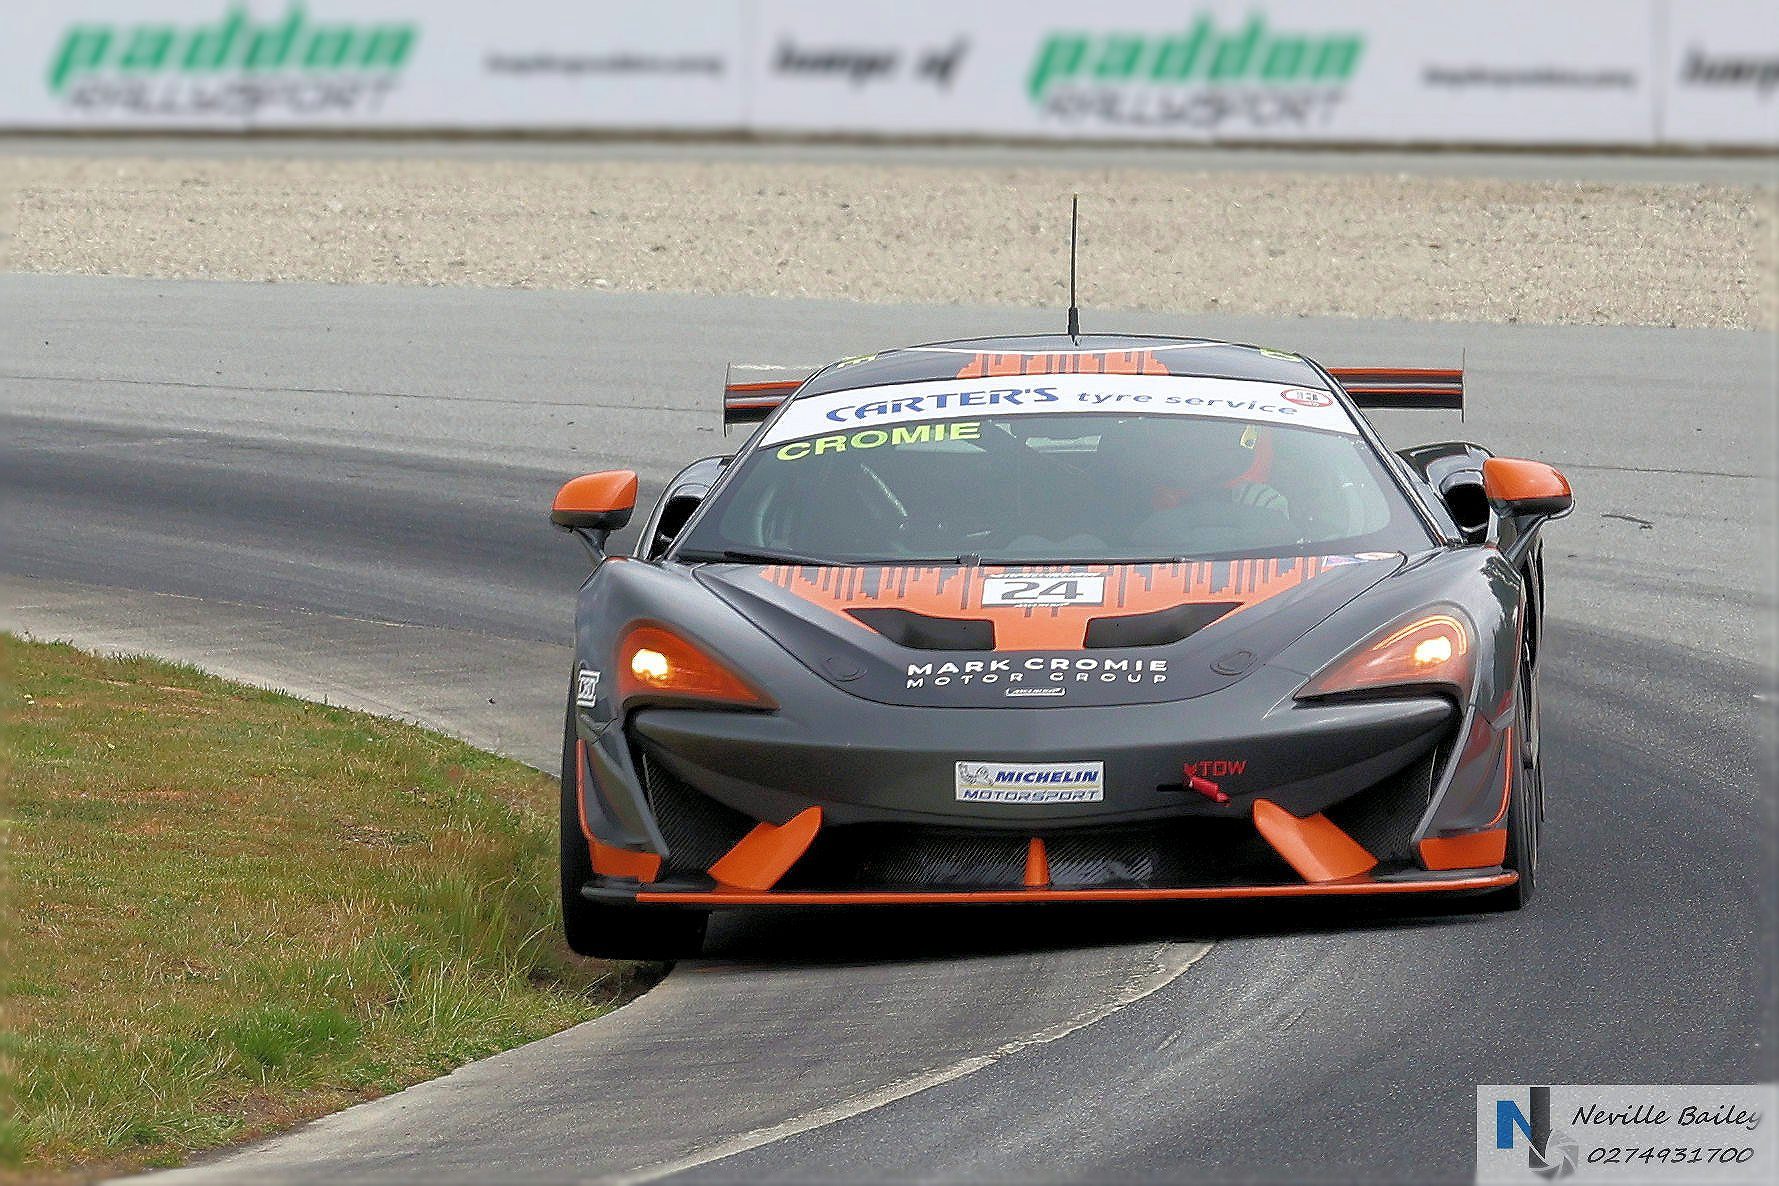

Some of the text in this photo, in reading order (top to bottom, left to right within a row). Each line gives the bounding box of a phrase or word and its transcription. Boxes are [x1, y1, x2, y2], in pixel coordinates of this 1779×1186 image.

[49, 5, 419, 97] paddon
[1027, 12, 1366, 98] paddon
[826, 386, 1059, 422] CARTER'S
[1077, 391, 1152, 404] tyre
[1164, 396, 1298, 415] service
[776, 422, 981, 461] CROMIE
[1001, 580, 1084, 600] 24
[907, 657, 1168, 676] MARK CROMIE
[906, 672, 1168, 689] MOTOR GROUP
[995, 769, 1099, 783] MICHELIN
[1198, 760, 1247, 776] TOW
[962, 789, 1098, 802] MOTORSPORT
